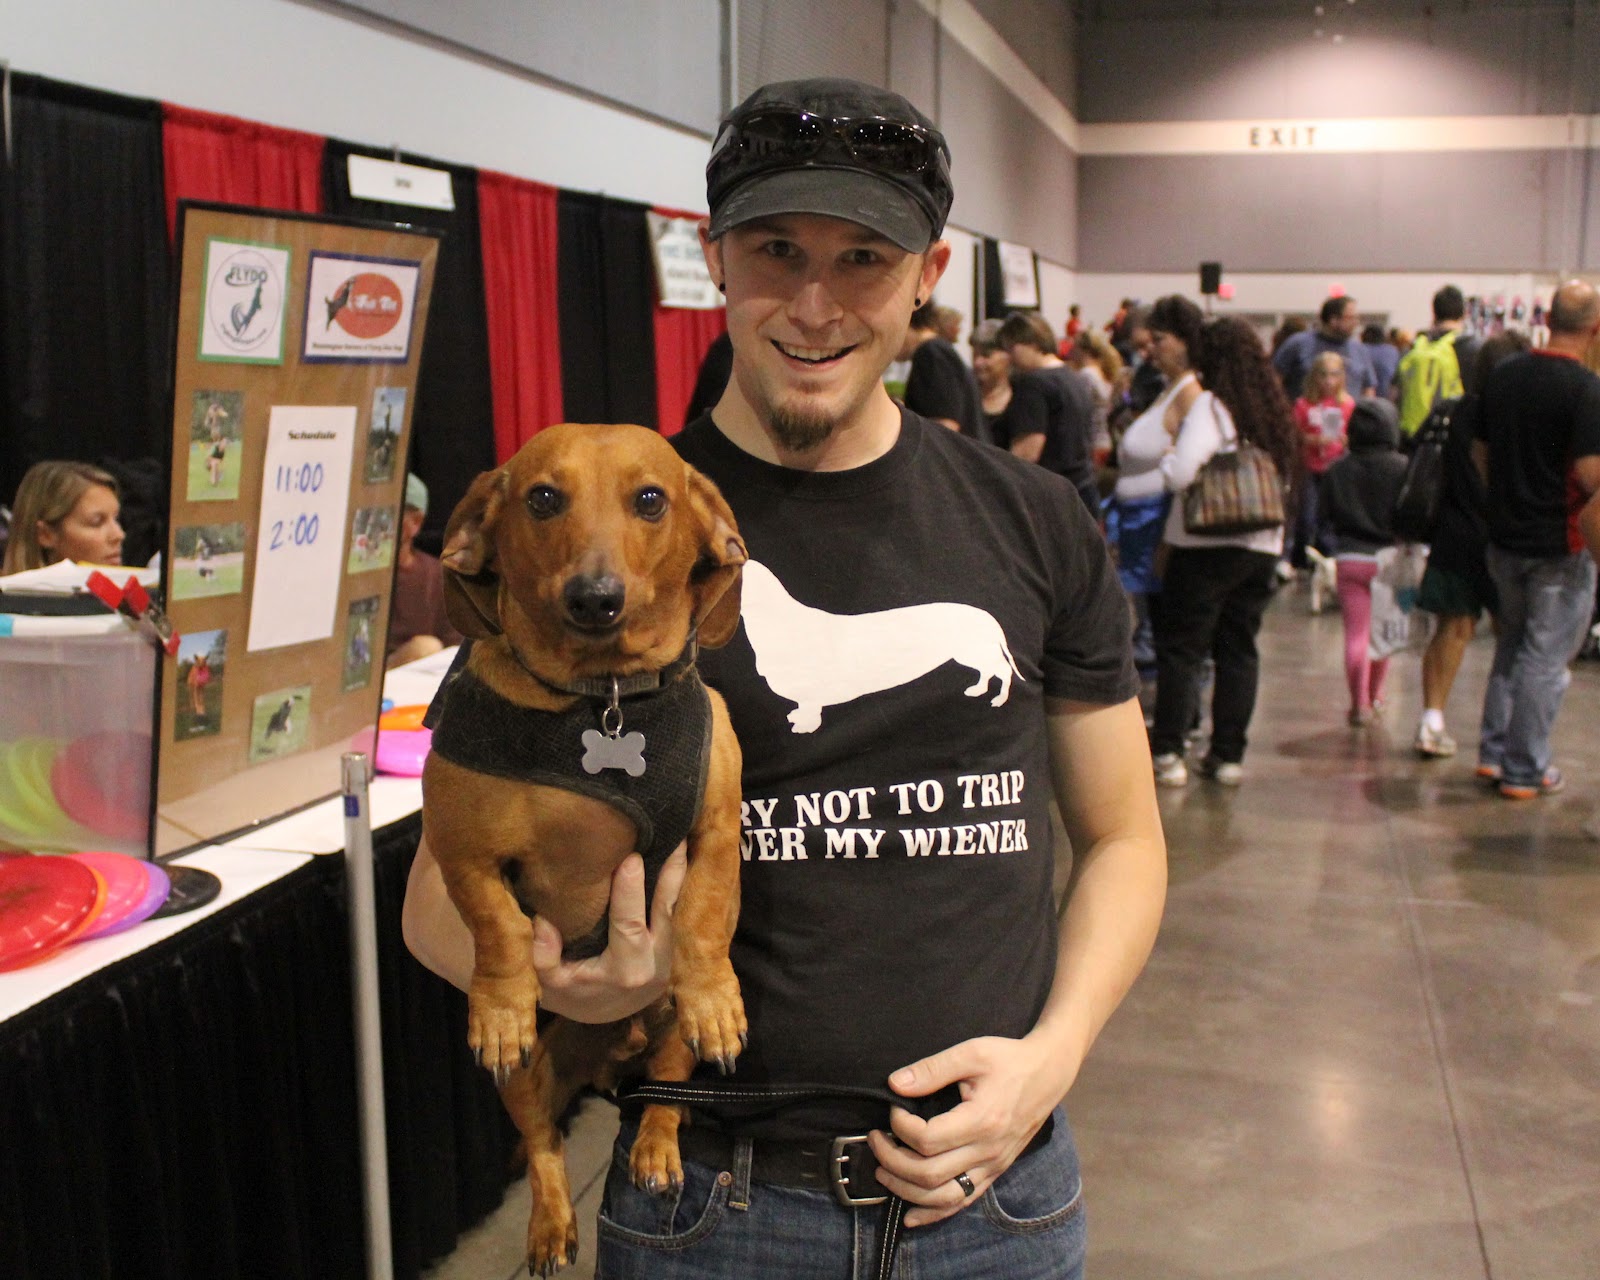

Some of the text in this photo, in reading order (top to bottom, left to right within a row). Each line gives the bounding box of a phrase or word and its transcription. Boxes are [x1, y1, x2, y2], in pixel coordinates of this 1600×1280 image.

[1250, 127, 1318, 147] EXIT
[287, 430, 337, 441] Schedule
[276, 462, 324, 493] 11:00
[269, 512, 320, 551] 2:00
[740, 770, 1025, 828] RY NOT TO TRIP
[740, 819, 1029, 861] VER MY WIENER
